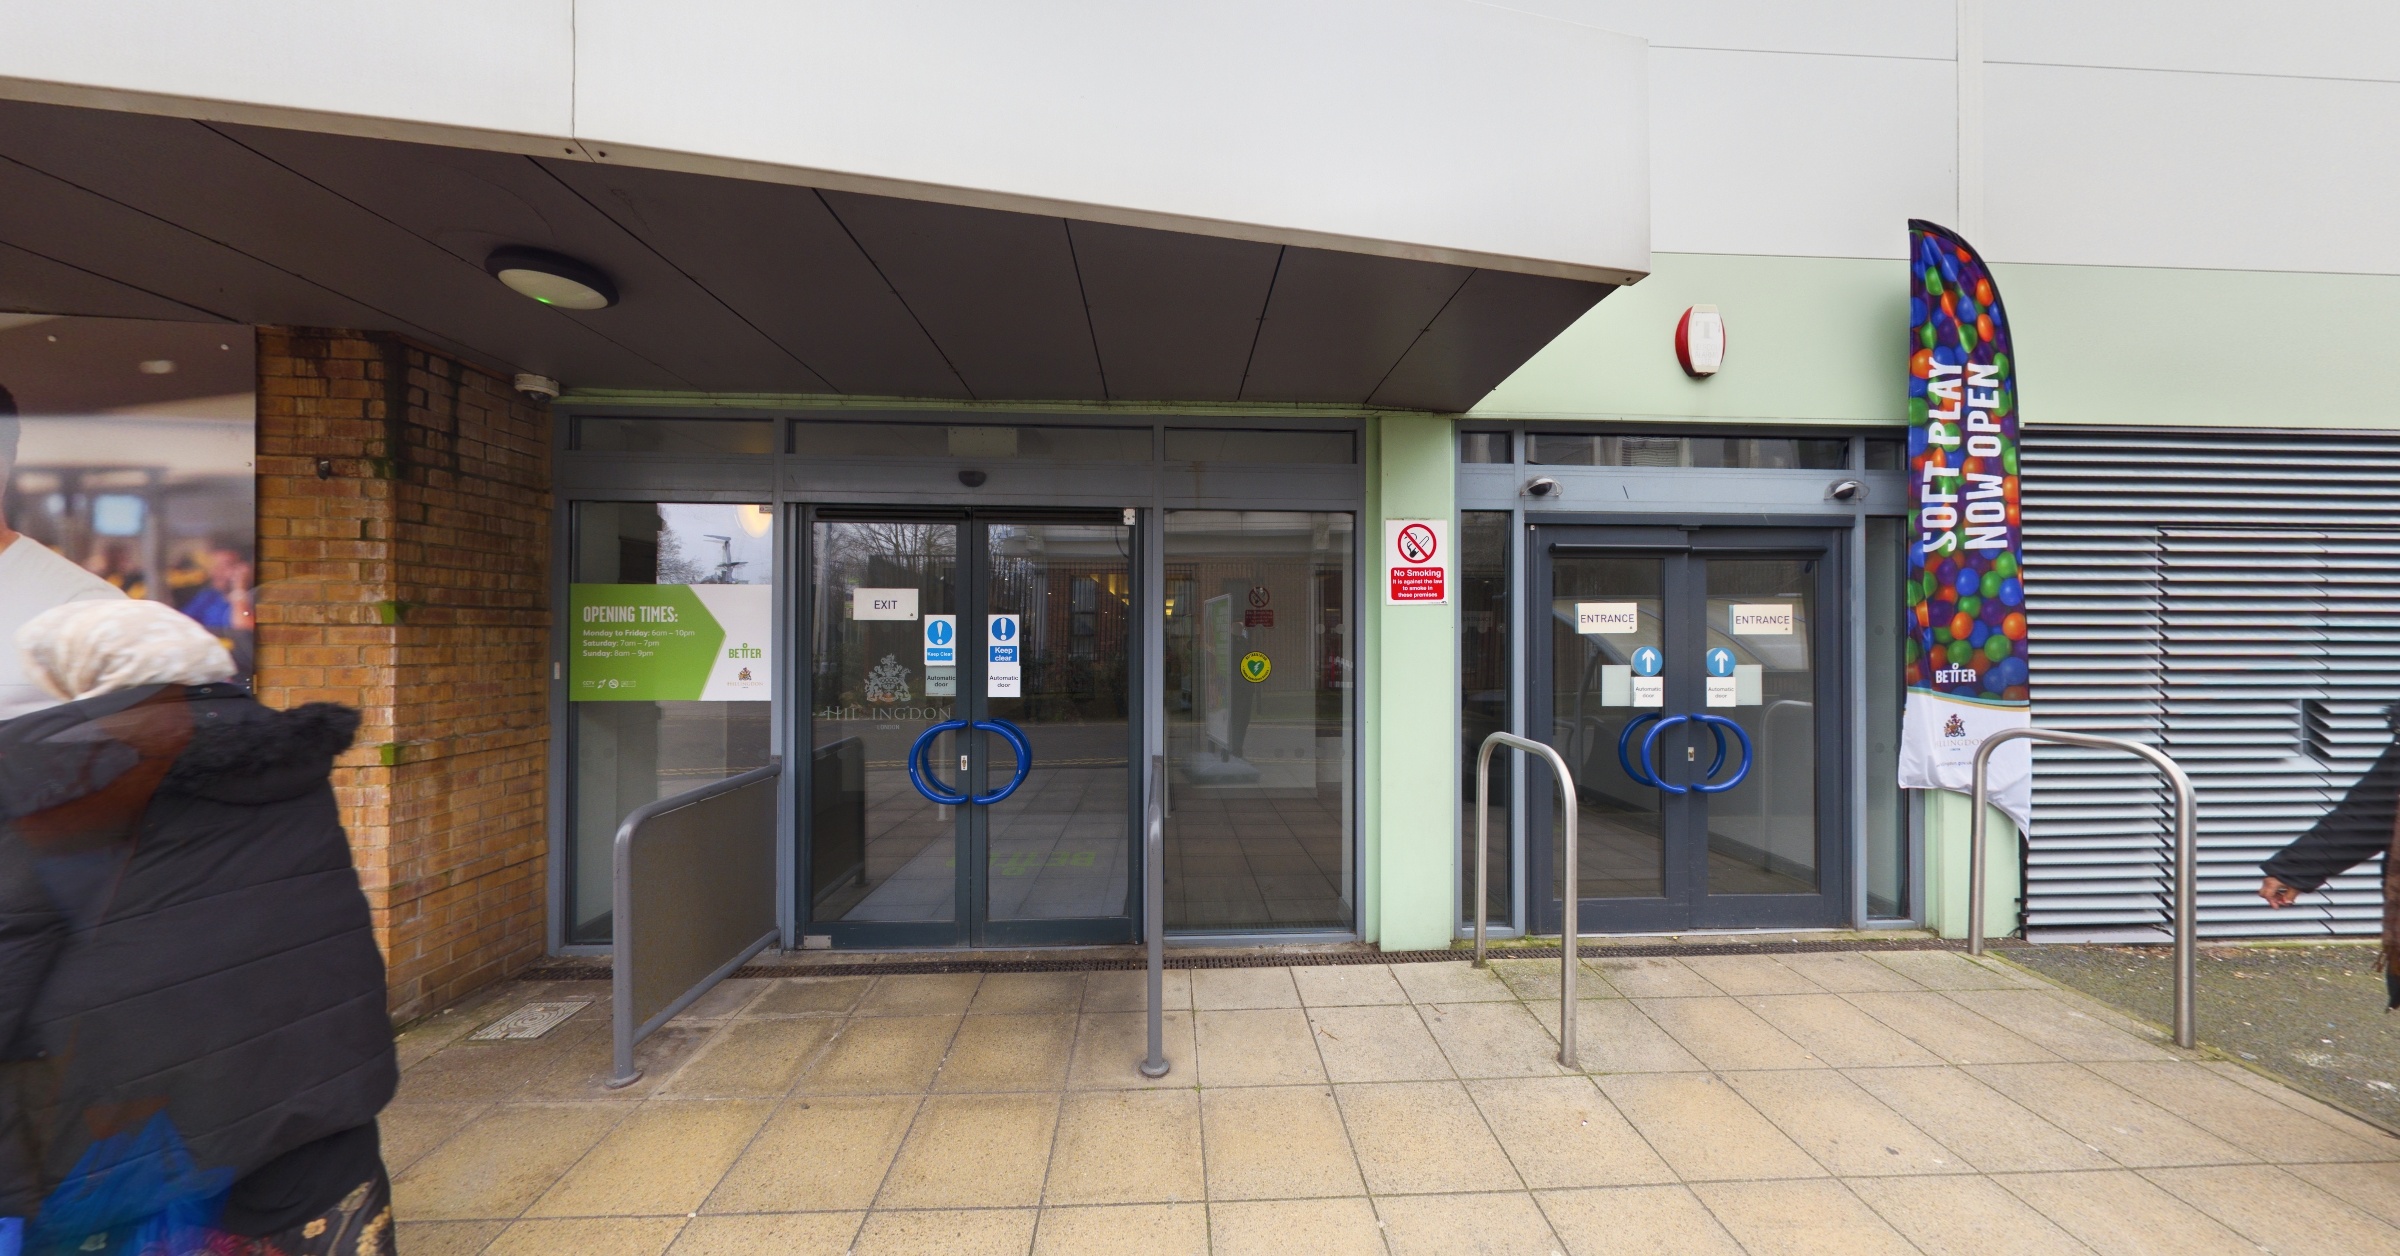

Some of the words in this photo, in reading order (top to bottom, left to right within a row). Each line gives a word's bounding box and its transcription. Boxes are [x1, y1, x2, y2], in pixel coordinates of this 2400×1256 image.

[1928, 356, 1962, 445] PLAY
[1967, 363, 2002, 458] OPEN
[1921, 460, 1960, 553] SOFT
[1964, 473, 2008, 550] NOW
[1406, 569, 1441, 578] Smoking
[874, 600, 898, 610] EXIT
[583, 606, 635, 622] OPENING
[639, 606, 679, 622] TIMES:
[1580, 613, 1635, 623] ENTRANCE
[1735, 615, 1791, 625] ENTRANCE
[583, 630, 613, 638] Monday
[625, 629, 650, 638] Friday:
[675, 630, 695, 638] 10pm
[583, 640, 618, 648] Saturday:
[644, 640, 659, 648] 7pm
[583, 650, 613, 658] Sunday:
[729, 648, 762, 659] BETTER
[1936, 669, 1977, 684] BETTER
[826, 706, 952, 720] HILINGDON
